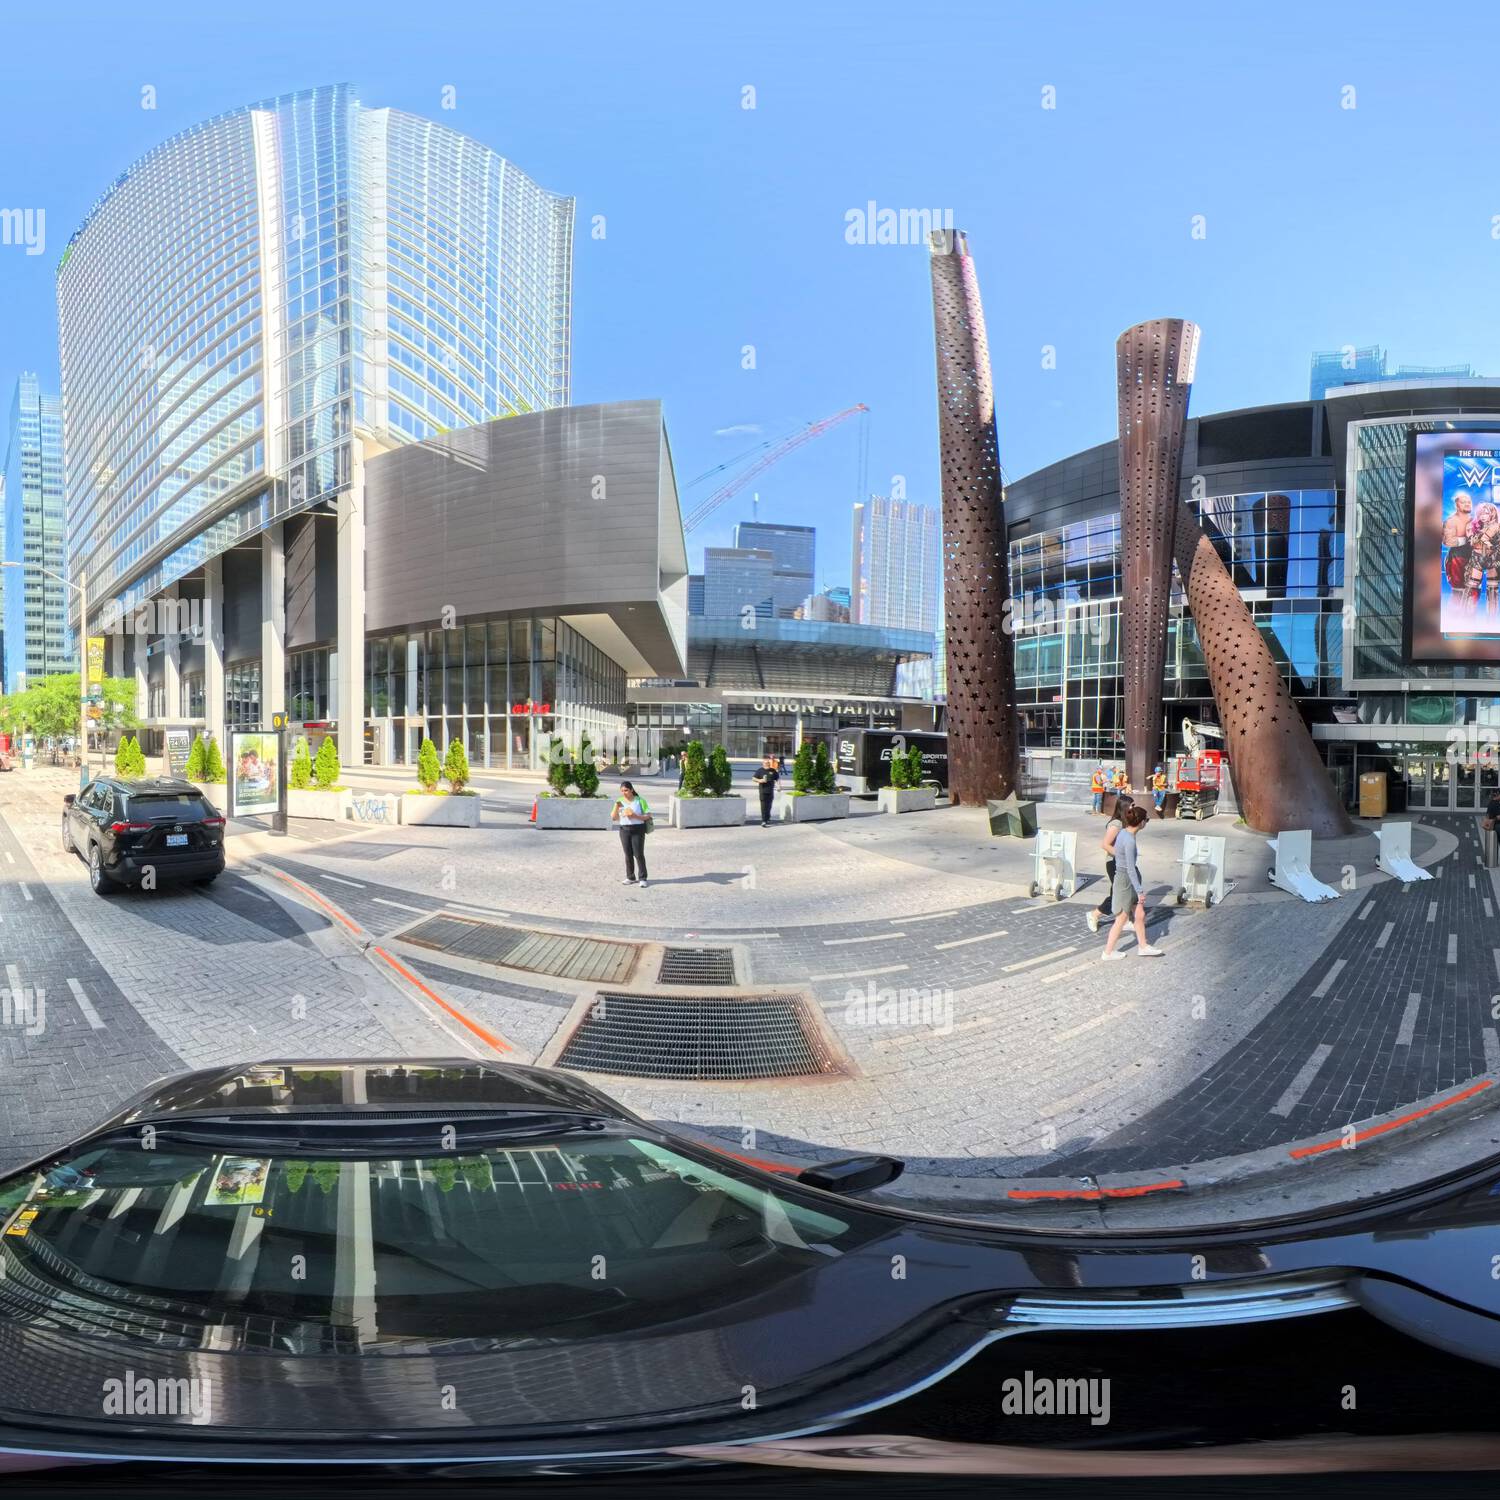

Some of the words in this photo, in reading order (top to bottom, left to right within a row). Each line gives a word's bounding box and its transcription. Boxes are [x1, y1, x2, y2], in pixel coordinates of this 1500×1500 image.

[1473, 450, 1492, 458] FINAL
[753, 696, 815, 713] UNION
[822, 698, 896, 717] STATION
